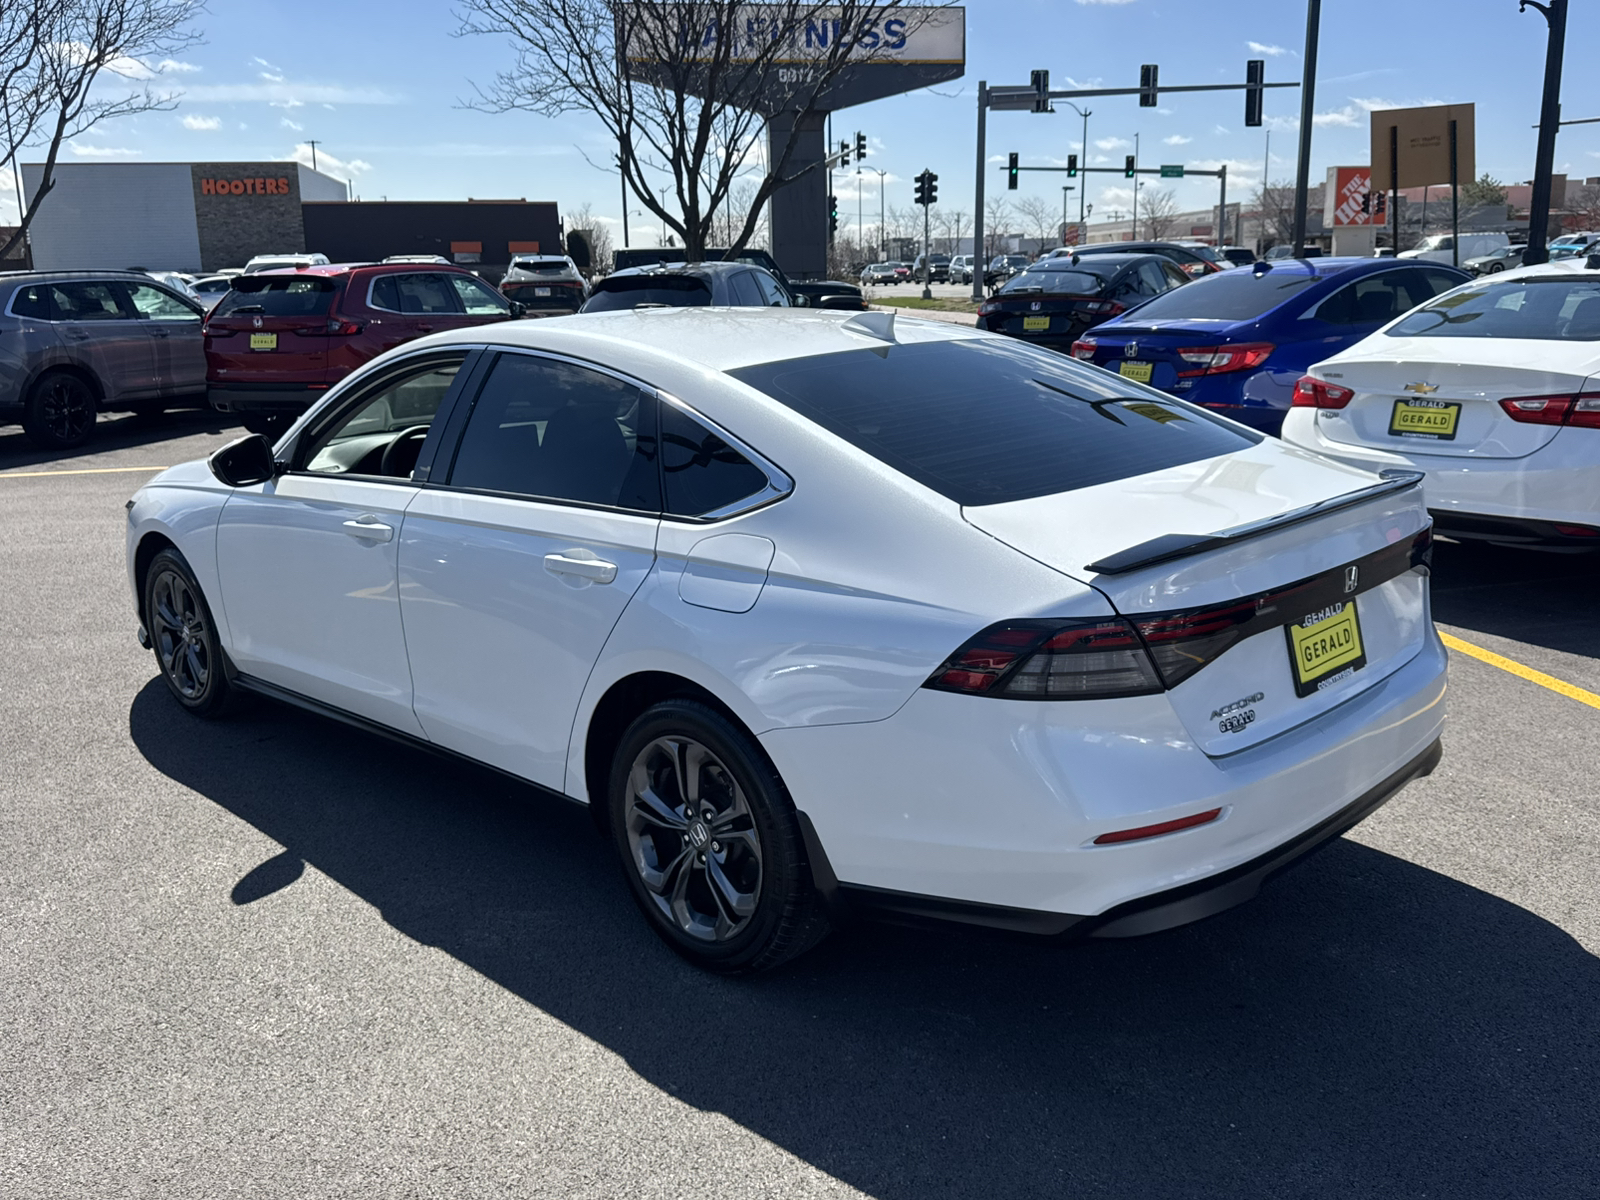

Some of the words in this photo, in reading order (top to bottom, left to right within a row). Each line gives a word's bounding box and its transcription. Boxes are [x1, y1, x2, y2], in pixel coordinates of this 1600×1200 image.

[201, 178, 289, 195] HOOTERS
[1341, 173, 1363, 197] THE
[1408, 400, 1446, 409] GERALD
[1402, 414, 1447, 426] GERALD
[1304, 602, 1343, 627] GERALD
[1304, 628, 1351, 663] GERALD
[1210, 692, 1265, 721] ACCORD
[1219, 709, 1256, 734] GERALD
